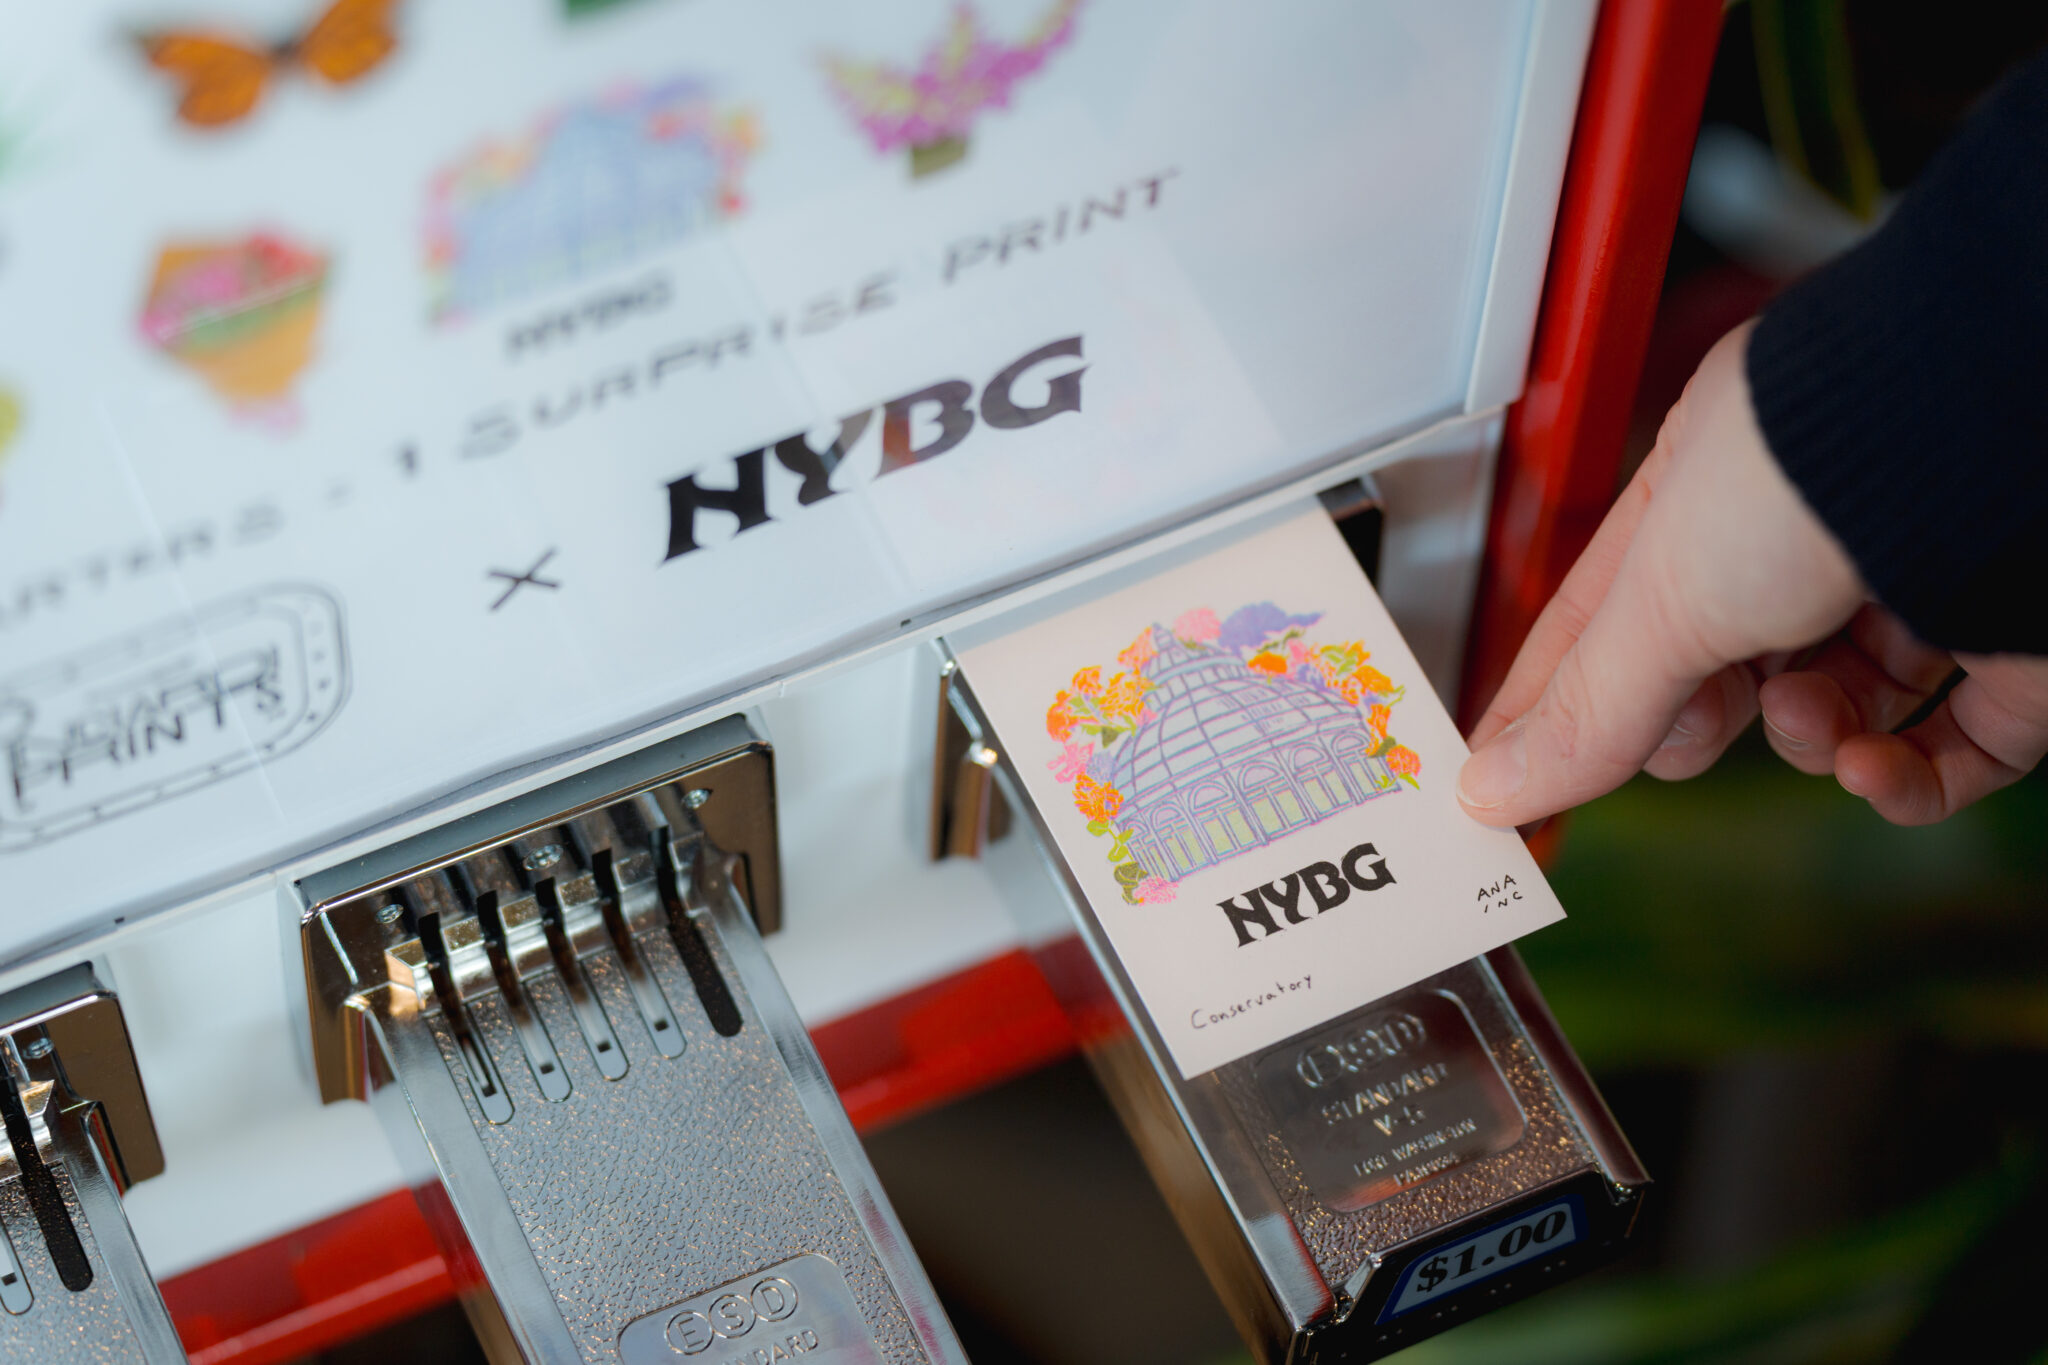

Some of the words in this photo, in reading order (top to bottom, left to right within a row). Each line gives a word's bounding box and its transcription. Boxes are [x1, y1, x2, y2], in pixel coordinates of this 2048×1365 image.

[456, 268, 898, 462] SURPRISE
[942, 167, 1181, 285] PRINT
[659, 335, 1091, 567] NYBG
[1216, 842, 1397, 948] NYBG
[1477, 874, 1517, 901] ANA
[1484, 891, 1523, 913] INC
[1190, 974, 1313, 1030] Conservatory
[1415, 1210, 1567, 1293] $1.00
